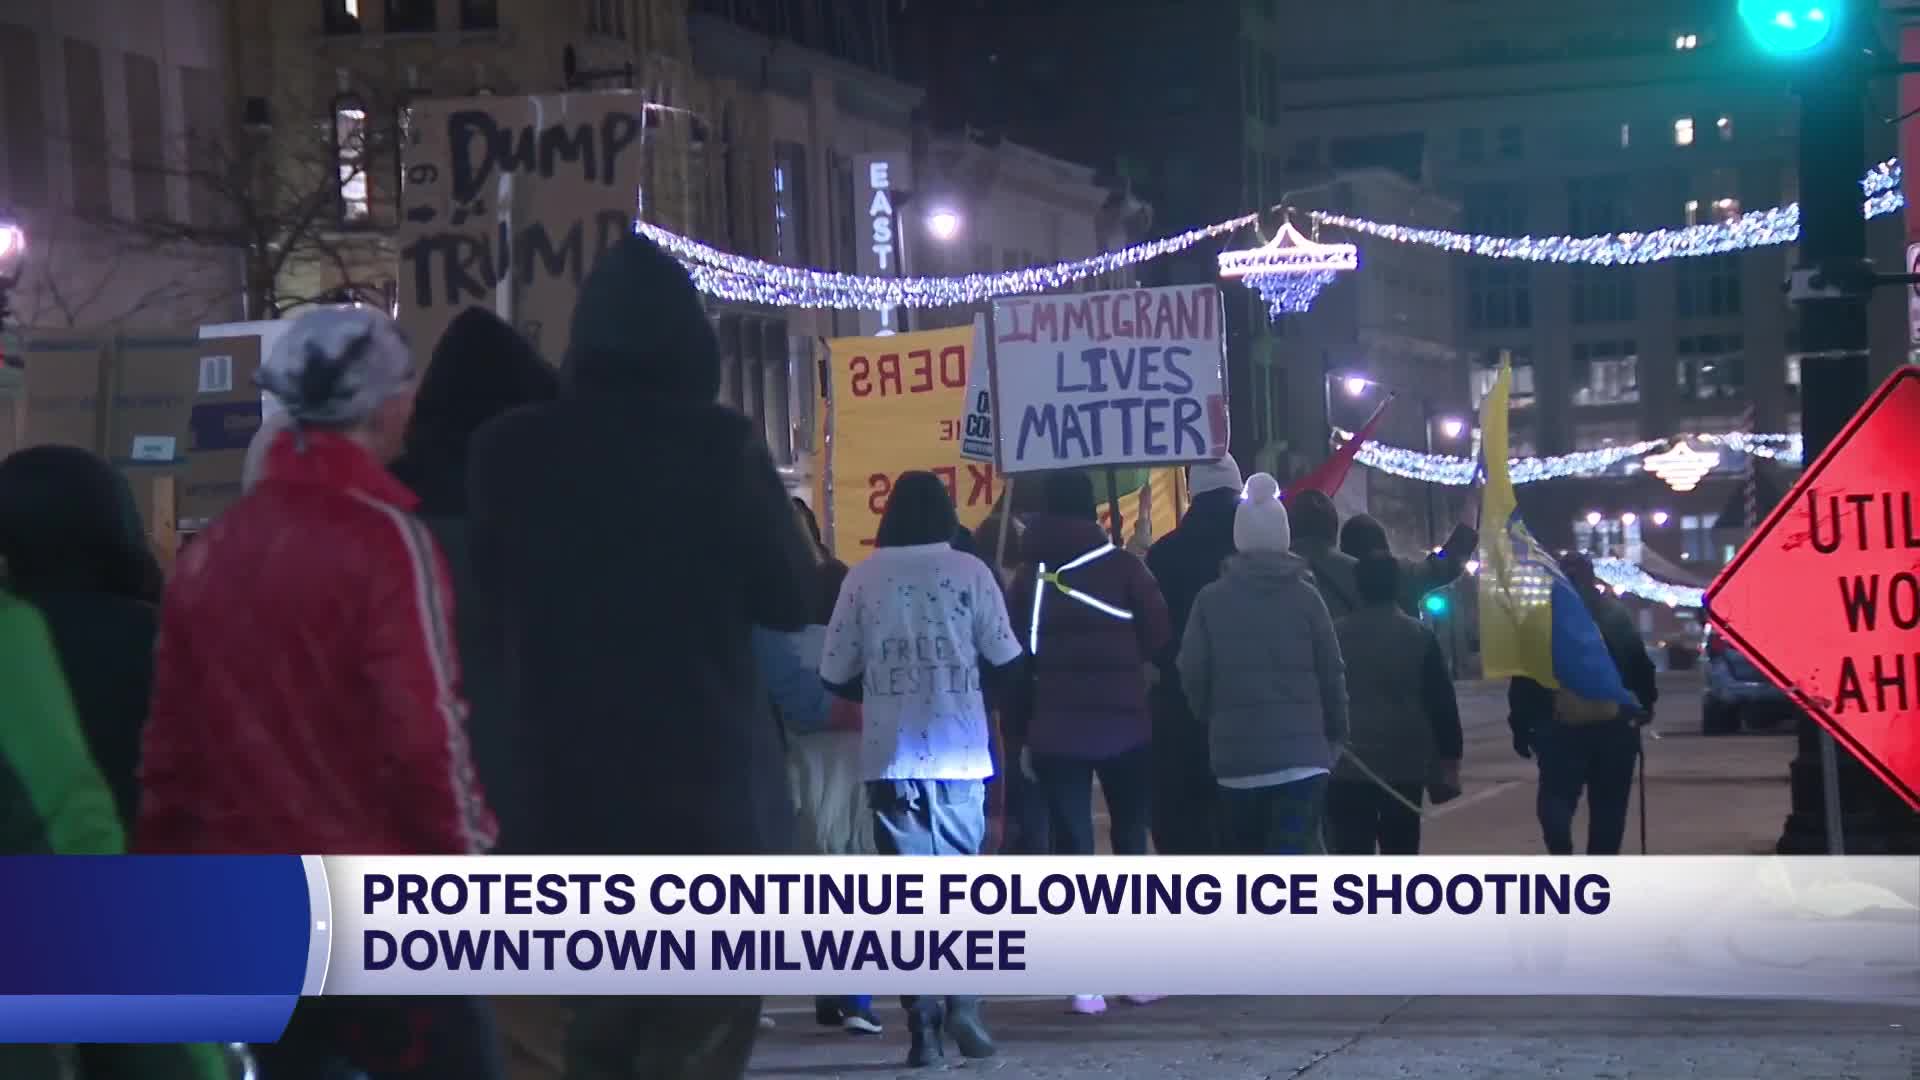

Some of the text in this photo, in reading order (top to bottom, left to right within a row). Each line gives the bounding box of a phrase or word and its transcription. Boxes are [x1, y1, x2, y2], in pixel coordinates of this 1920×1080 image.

[448, 110, 638, 201] DUMP
[869, 162, 893, 269] EAST
[998, 288, 1216, 343] IMMIGRANT
[1057, 346, 1193, 394] LIVES
[1807, 488, 1920, 554] UTIL
[882, 636, 951, 663] FREE
